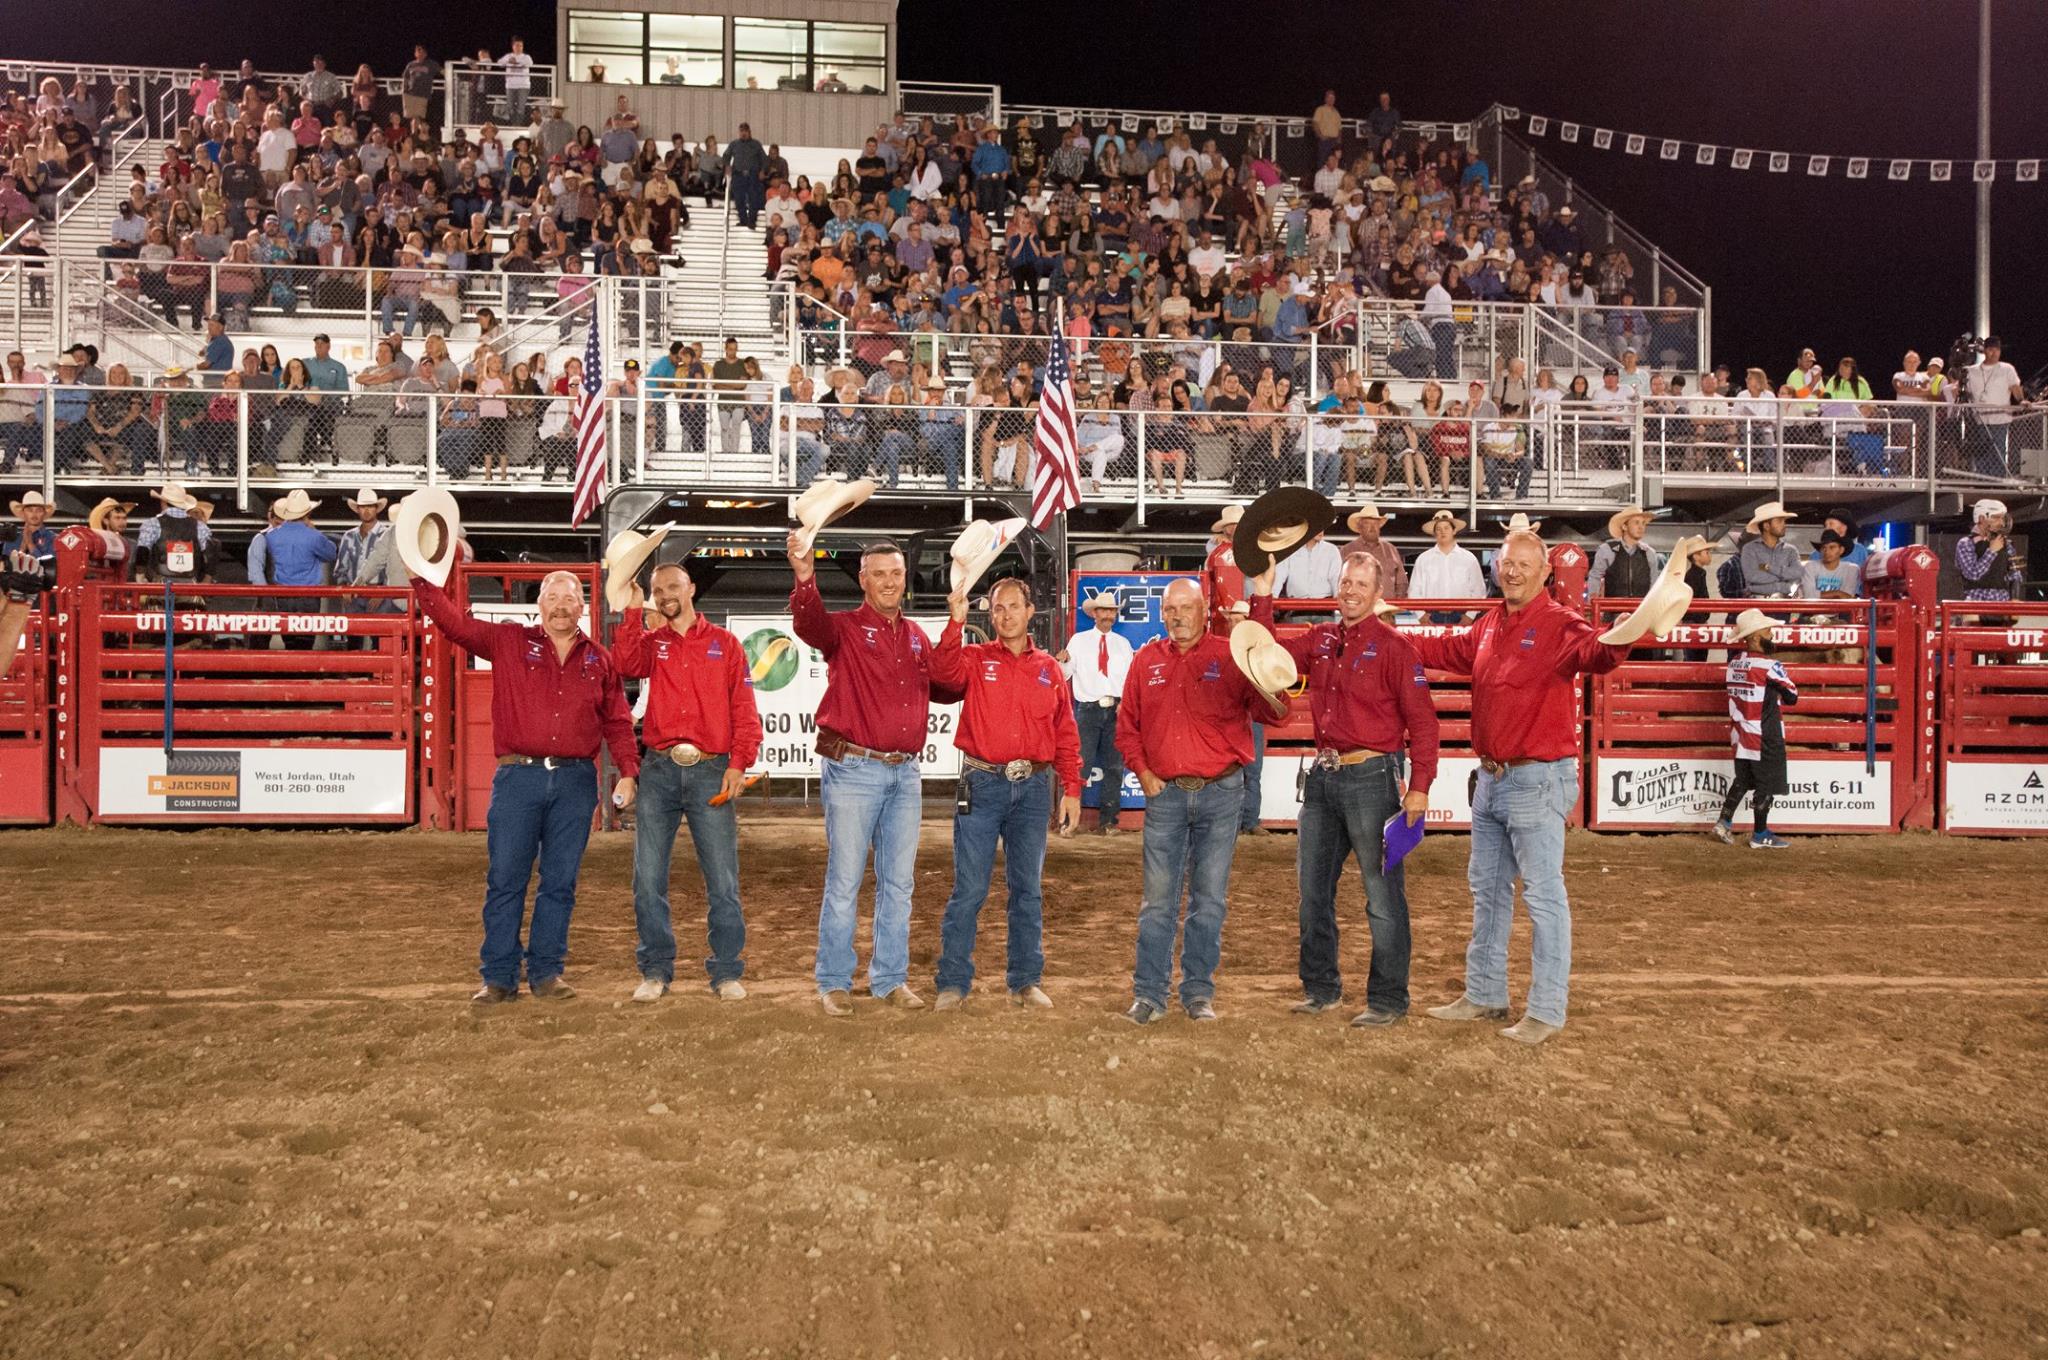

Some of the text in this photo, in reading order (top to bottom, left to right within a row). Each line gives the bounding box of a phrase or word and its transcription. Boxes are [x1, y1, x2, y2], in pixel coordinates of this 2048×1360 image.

[176, 555, 186, 566] 21
[136, 613, 349, 633] UT STAMPEDE RODEO
[1799, 627, 1859, 645] RODEO
[2007, 629, 2044, 647] UTE
[254, 771, 355, 783] West Jordan, Utah
[1638, 762, 1680, 781] JUAB
[168, 781, 231, 791] JACKSON
[263, 783, 346, 794] 801-260-0988
[1611, 770, 1728, 807] COUNTY FAIR
[1829, 780, 1863, 794] 6-11
[173, 799, 238, 809] CONSTRUCTION
